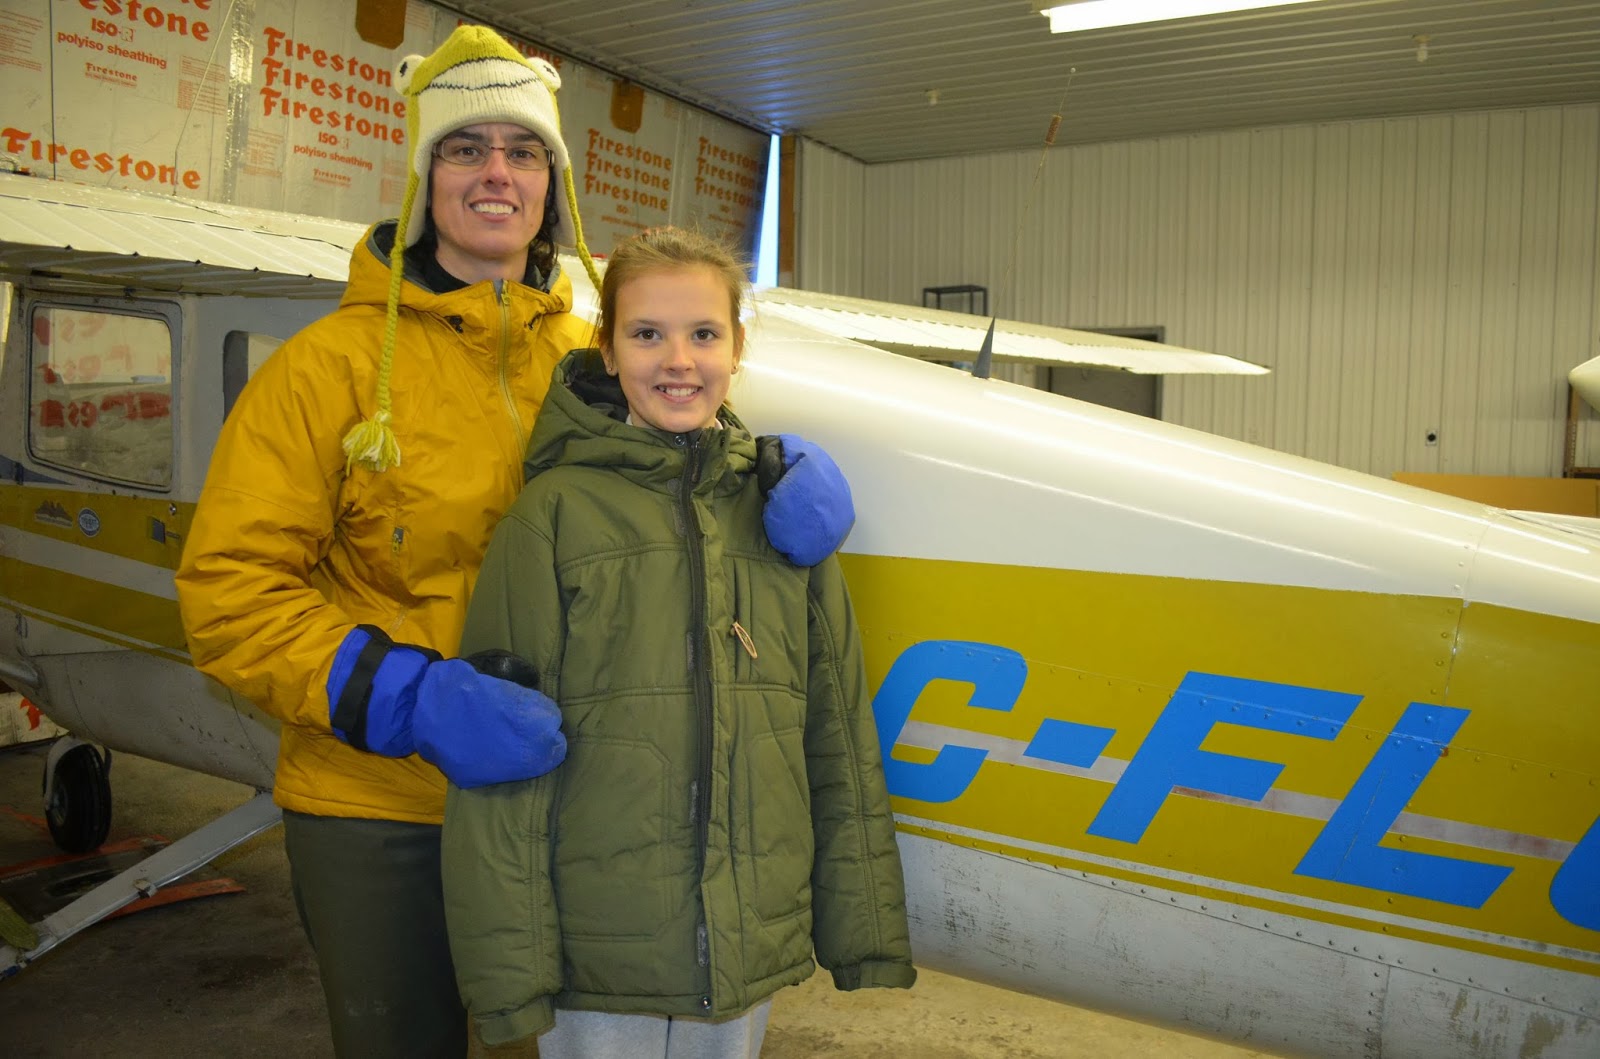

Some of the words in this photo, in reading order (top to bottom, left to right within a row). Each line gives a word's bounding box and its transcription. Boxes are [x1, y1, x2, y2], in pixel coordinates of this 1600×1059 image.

[57, 31, 104, 51] polyiso
[107, 44, 167, 70] sheathing
[85, 62, 137, 81] Firestone
[263, 26, 392, 88] Fireston
[261, 56, 406, 119] Firestone
[260, 87, 405, 145] Firestone
[1, 126, 202, 190] Firestone
[293, 144, 327, 159] polyiso
[329, 152, 373, 171] sheathing
[587, 127, 673, 171] Firestone
[584, 172, 668, 212] Firestone
[585, 150, 671, 192] Firestone
